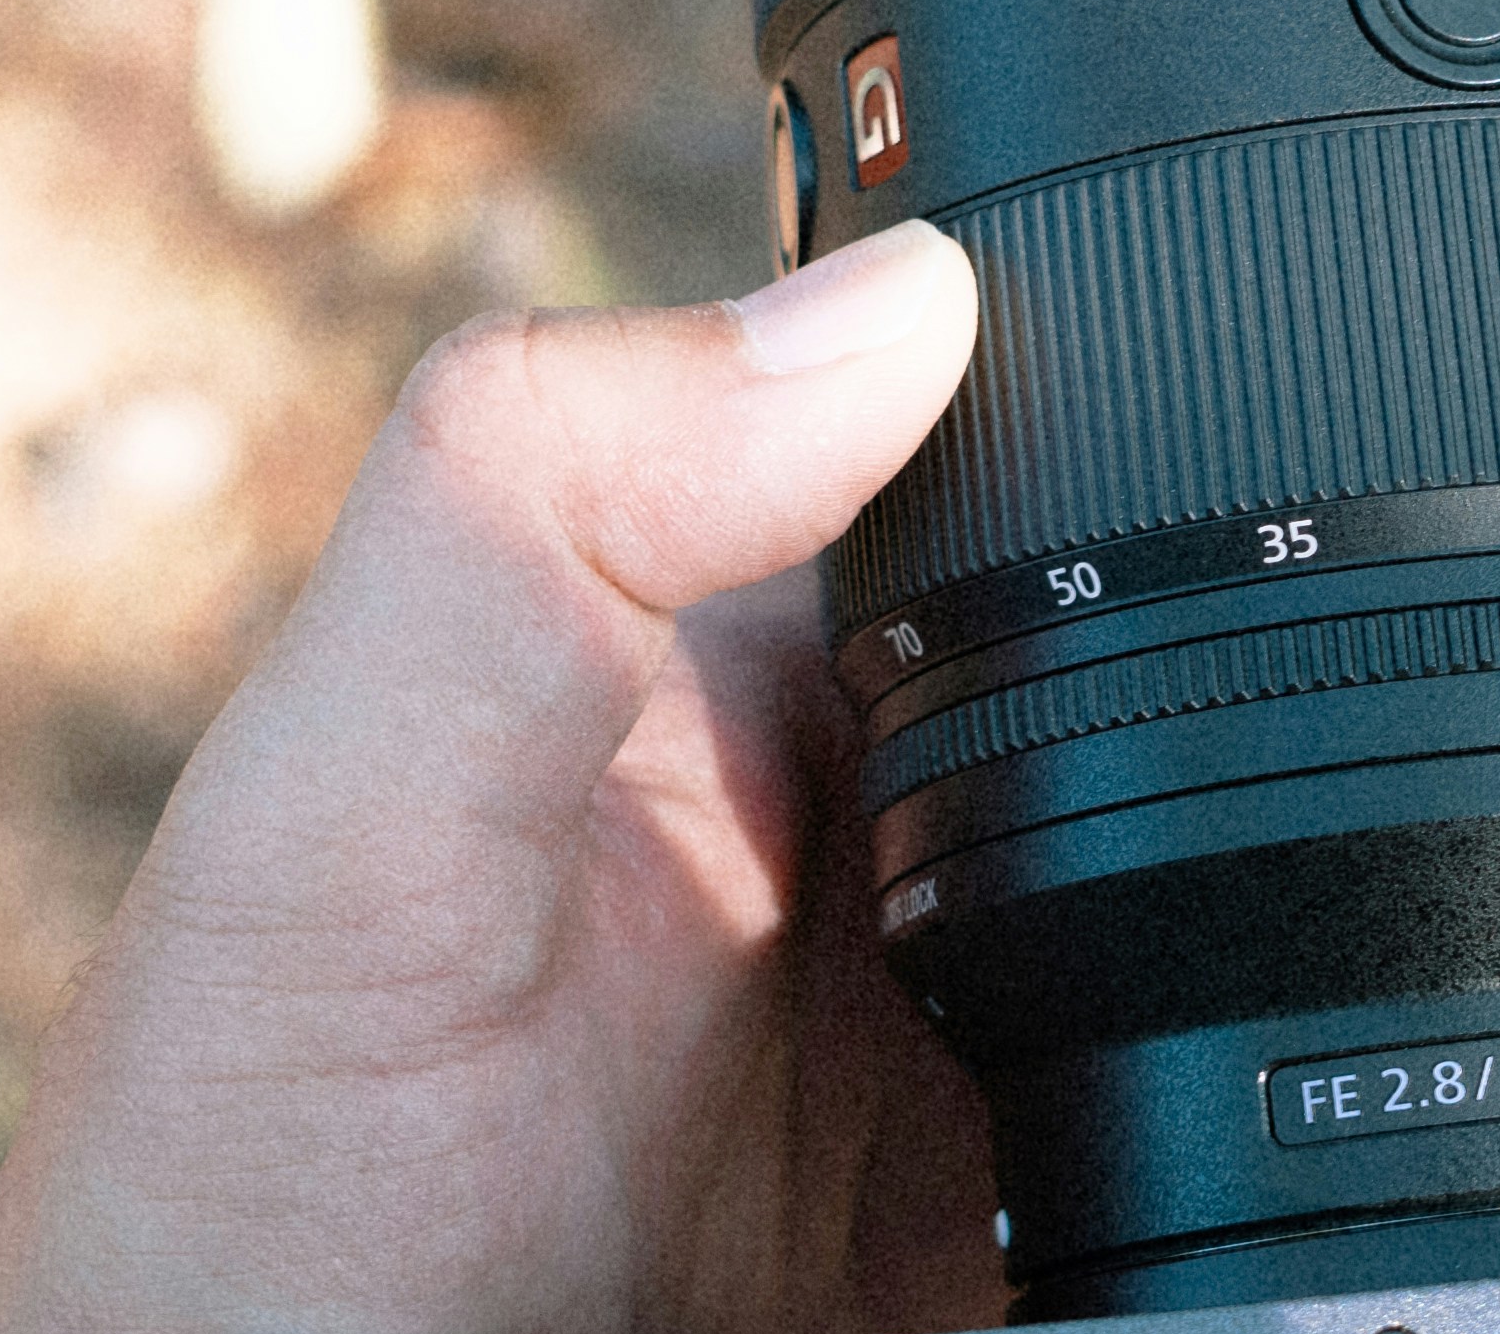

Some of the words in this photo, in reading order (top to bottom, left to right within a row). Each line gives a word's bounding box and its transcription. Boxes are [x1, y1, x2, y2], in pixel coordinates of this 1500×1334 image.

[883, 621, 924, 663] 70
[1046, 561, 1102, 606] 50
[1257, 519, 1319, 564] 35
[1301, 1074, 1361, 1124] FE
